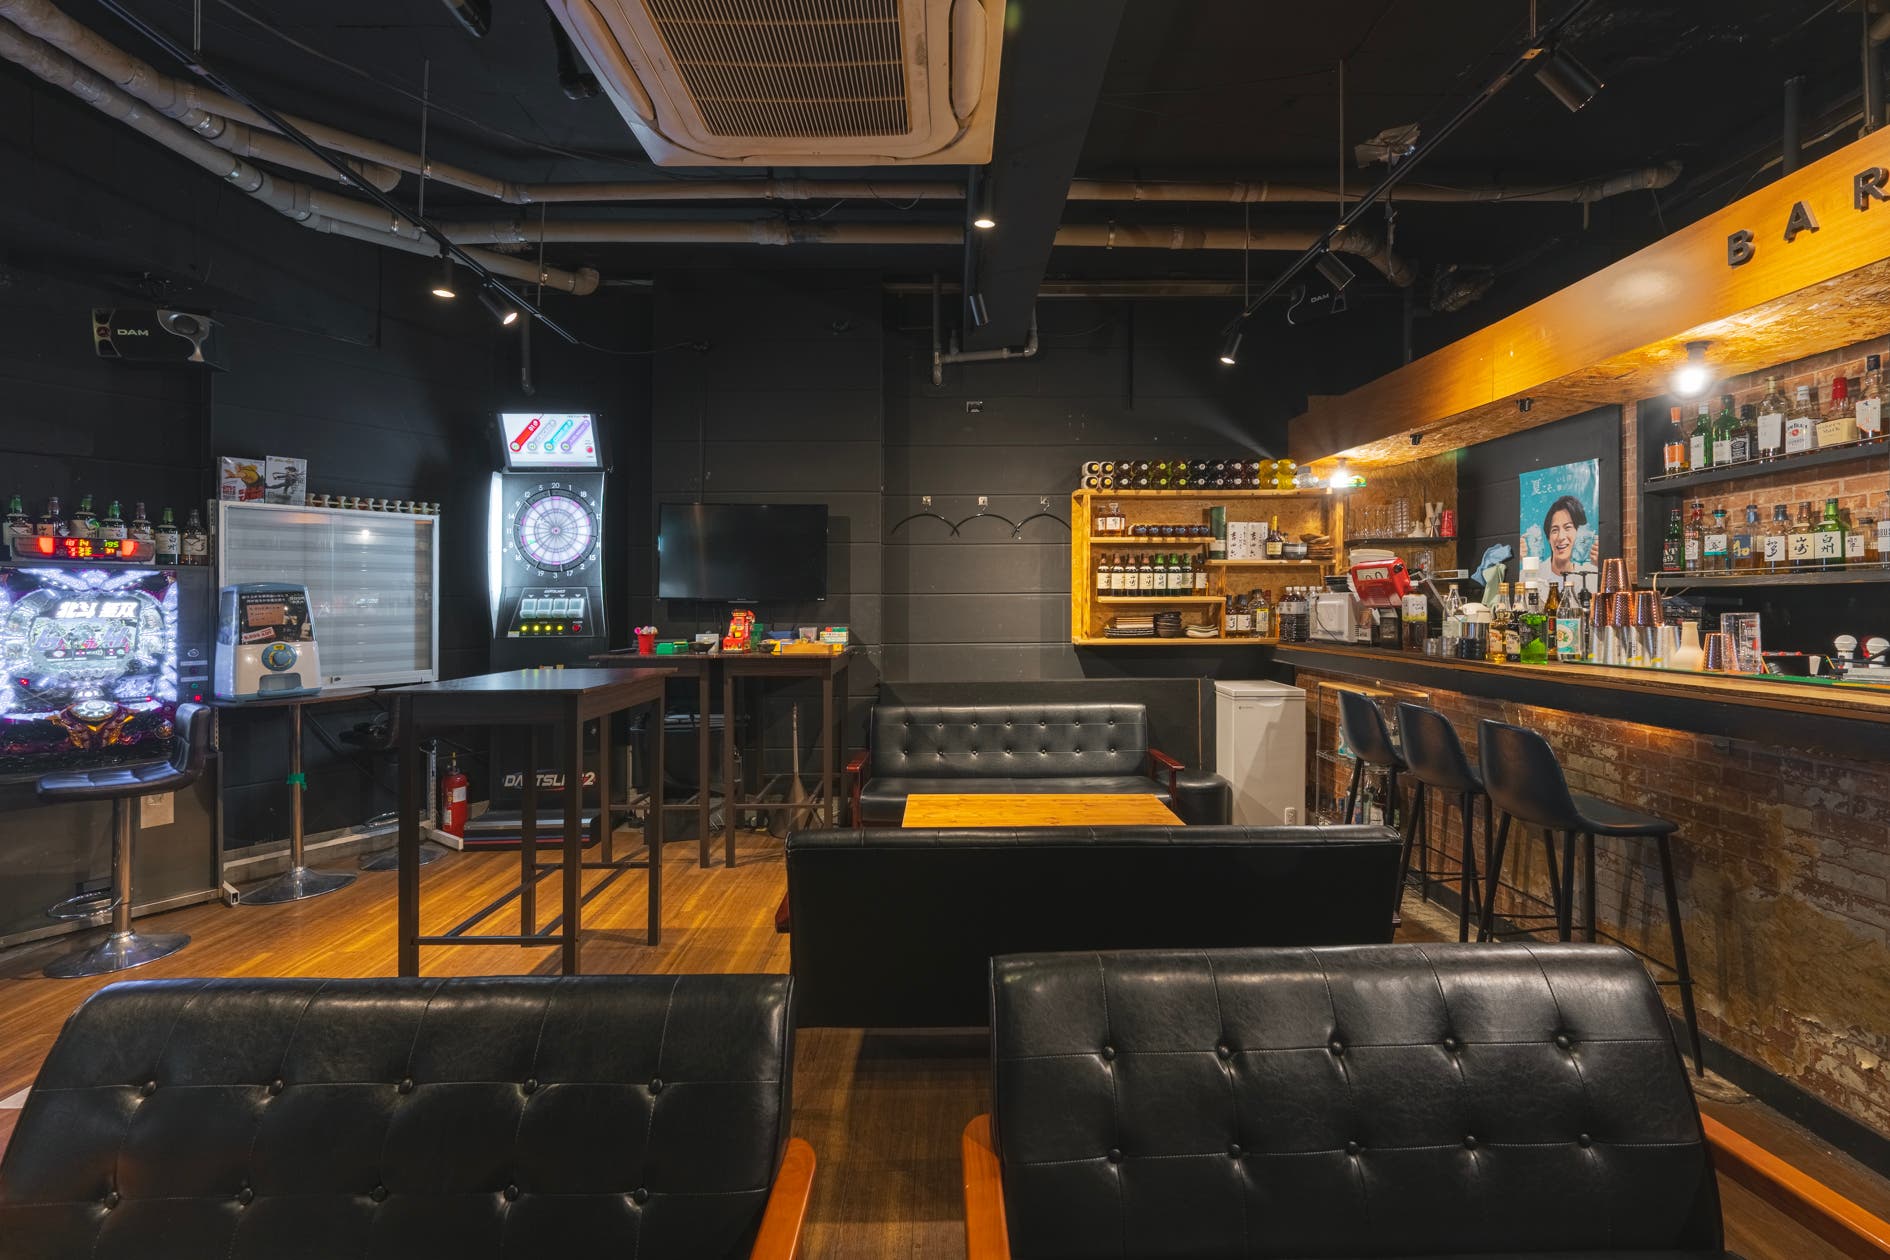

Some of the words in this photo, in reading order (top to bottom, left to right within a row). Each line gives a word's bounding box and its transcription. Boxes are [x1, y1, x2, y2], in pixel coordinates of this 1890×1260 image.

[1727, 167, 1890, 270] BAR
[117, 328, 149, 336] DAM
[1821, 534, 1835, 554] 白州
